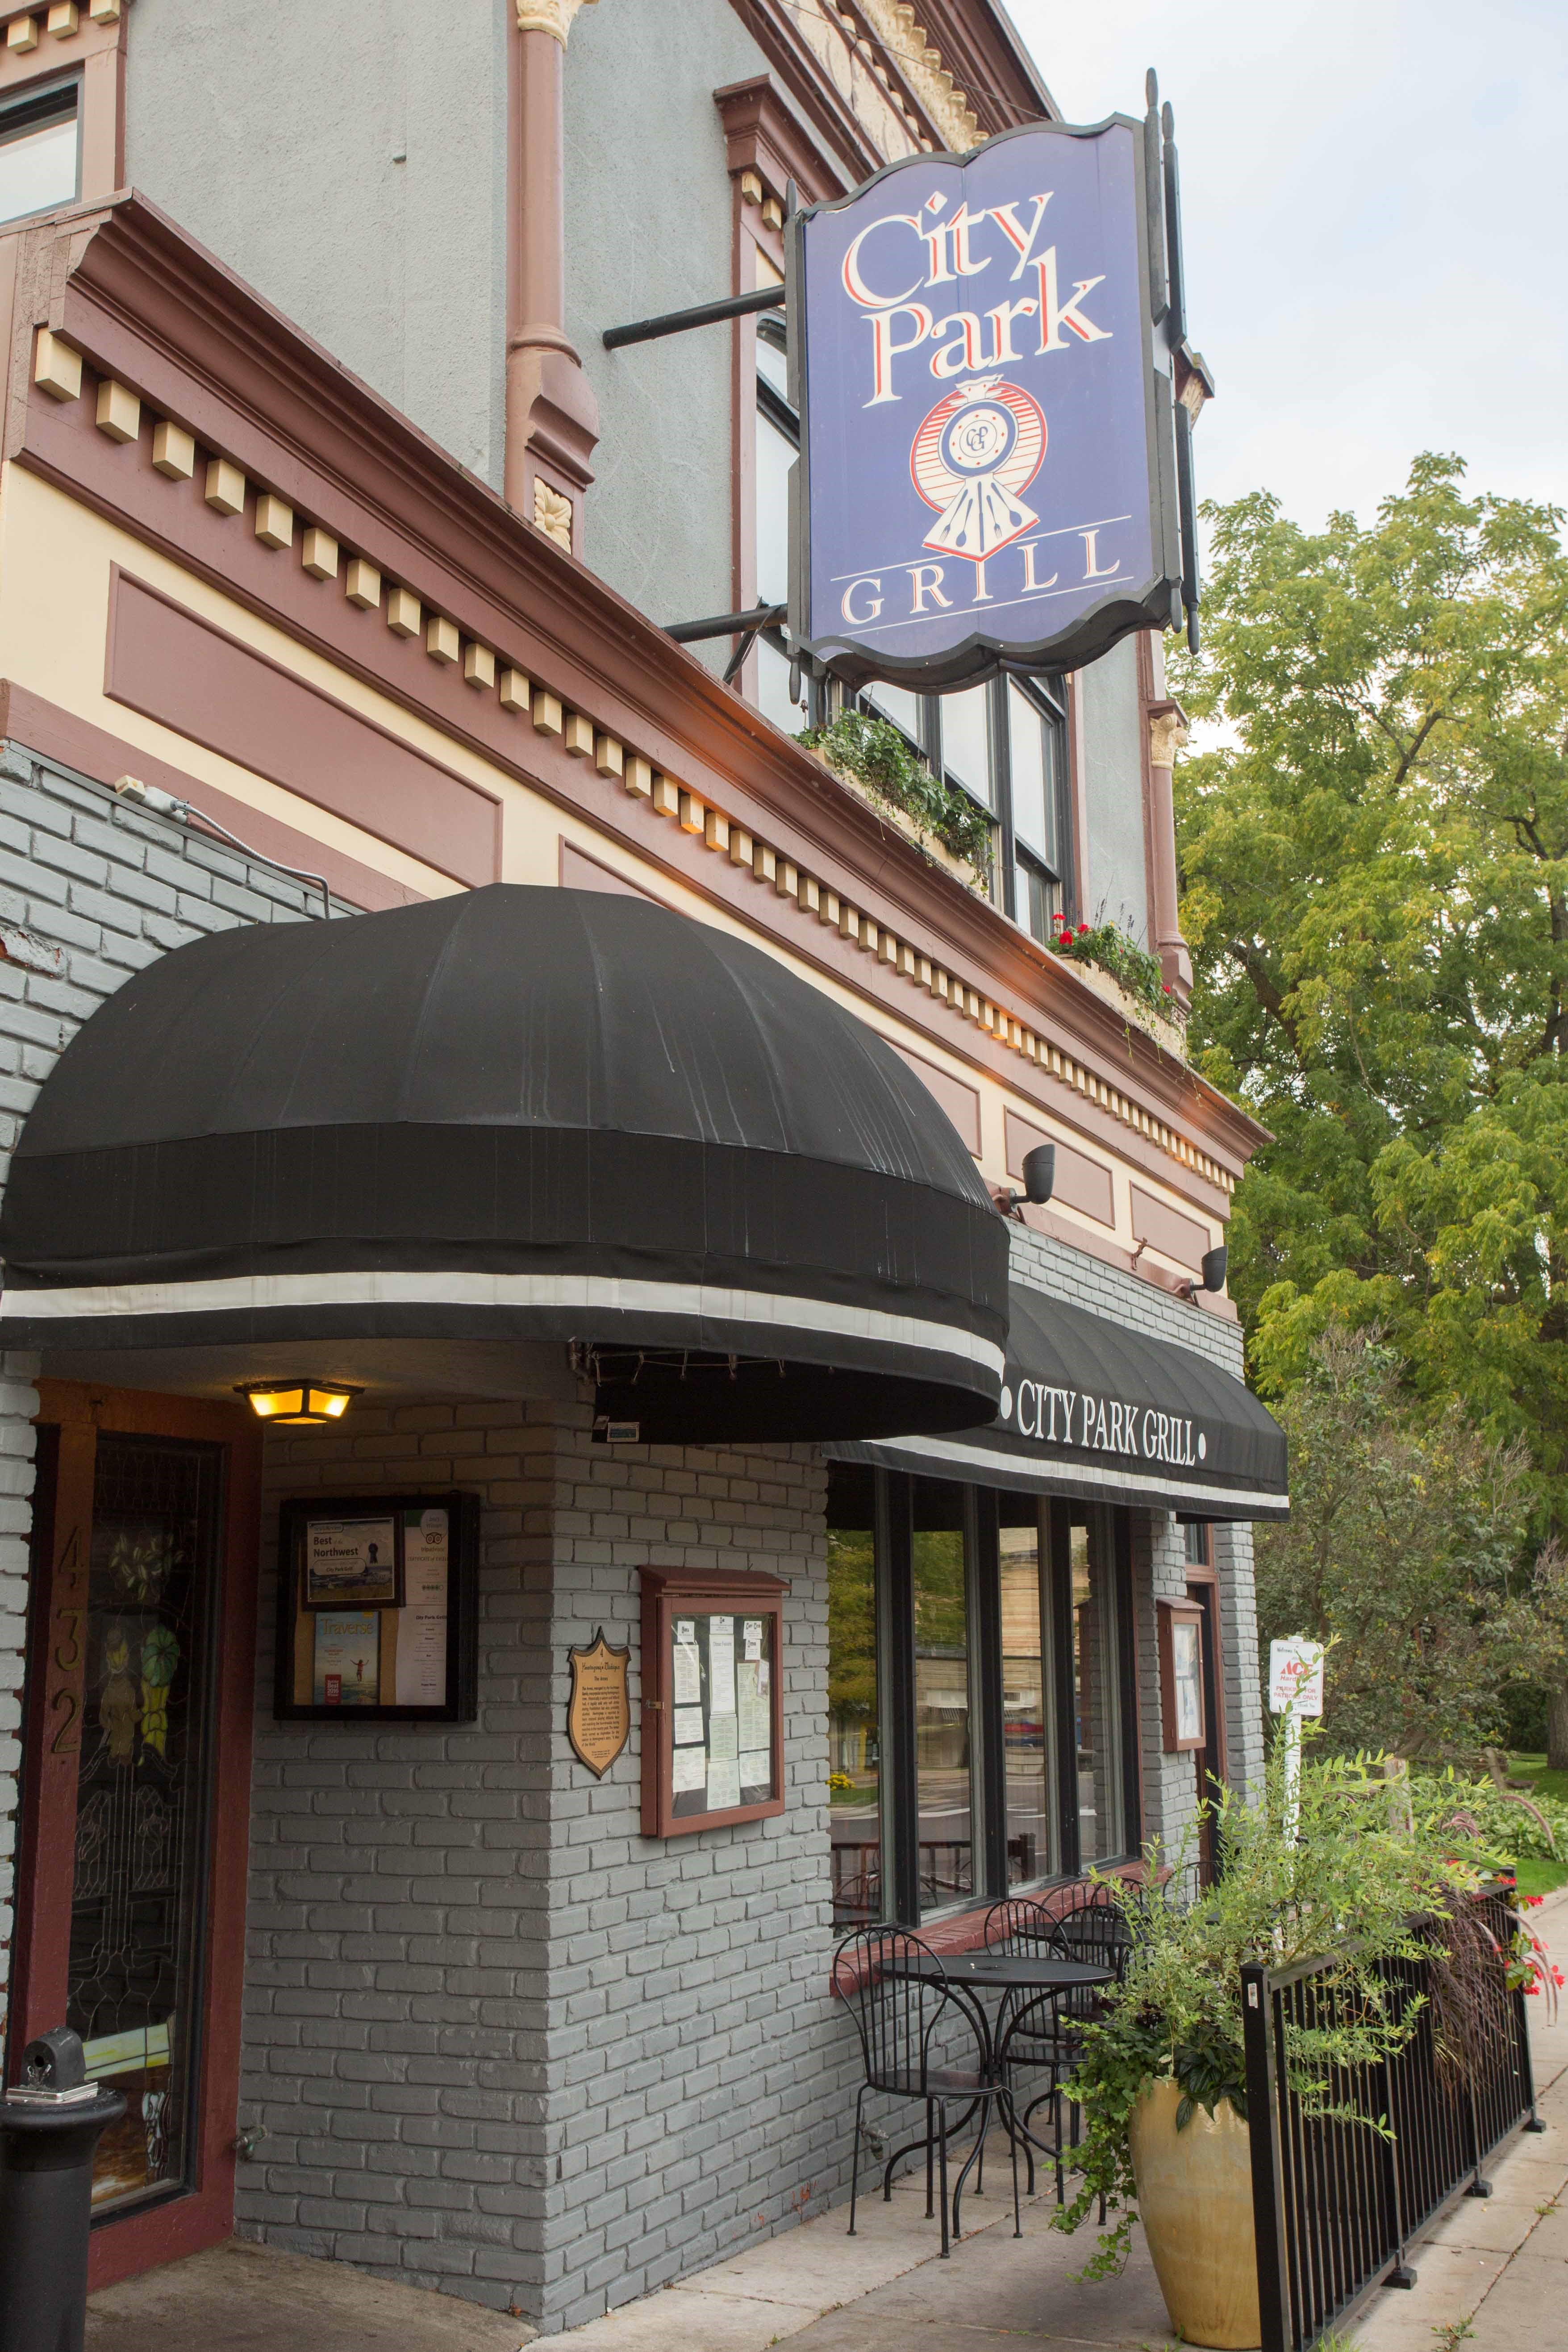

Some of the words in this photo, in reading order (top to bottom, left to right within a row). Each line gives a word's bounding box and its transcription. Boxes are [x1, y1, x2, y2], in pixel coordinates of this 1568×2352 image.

[841, 190, 1054, 309] City
[860, 245, 1113, 408] Park
[842, 530, 1120, 624] GRILL
[1018, 1379, 1076, 1443] CITY
[1081, 1394, 1138, 1455] PARK
[1143, 1410, 1195, 1466] GRILL
[314, 1536, 332, 1545] Best
[314, 1547, 358, 1557] Northwest
[321, 1618, 374, 1635] Traverse
